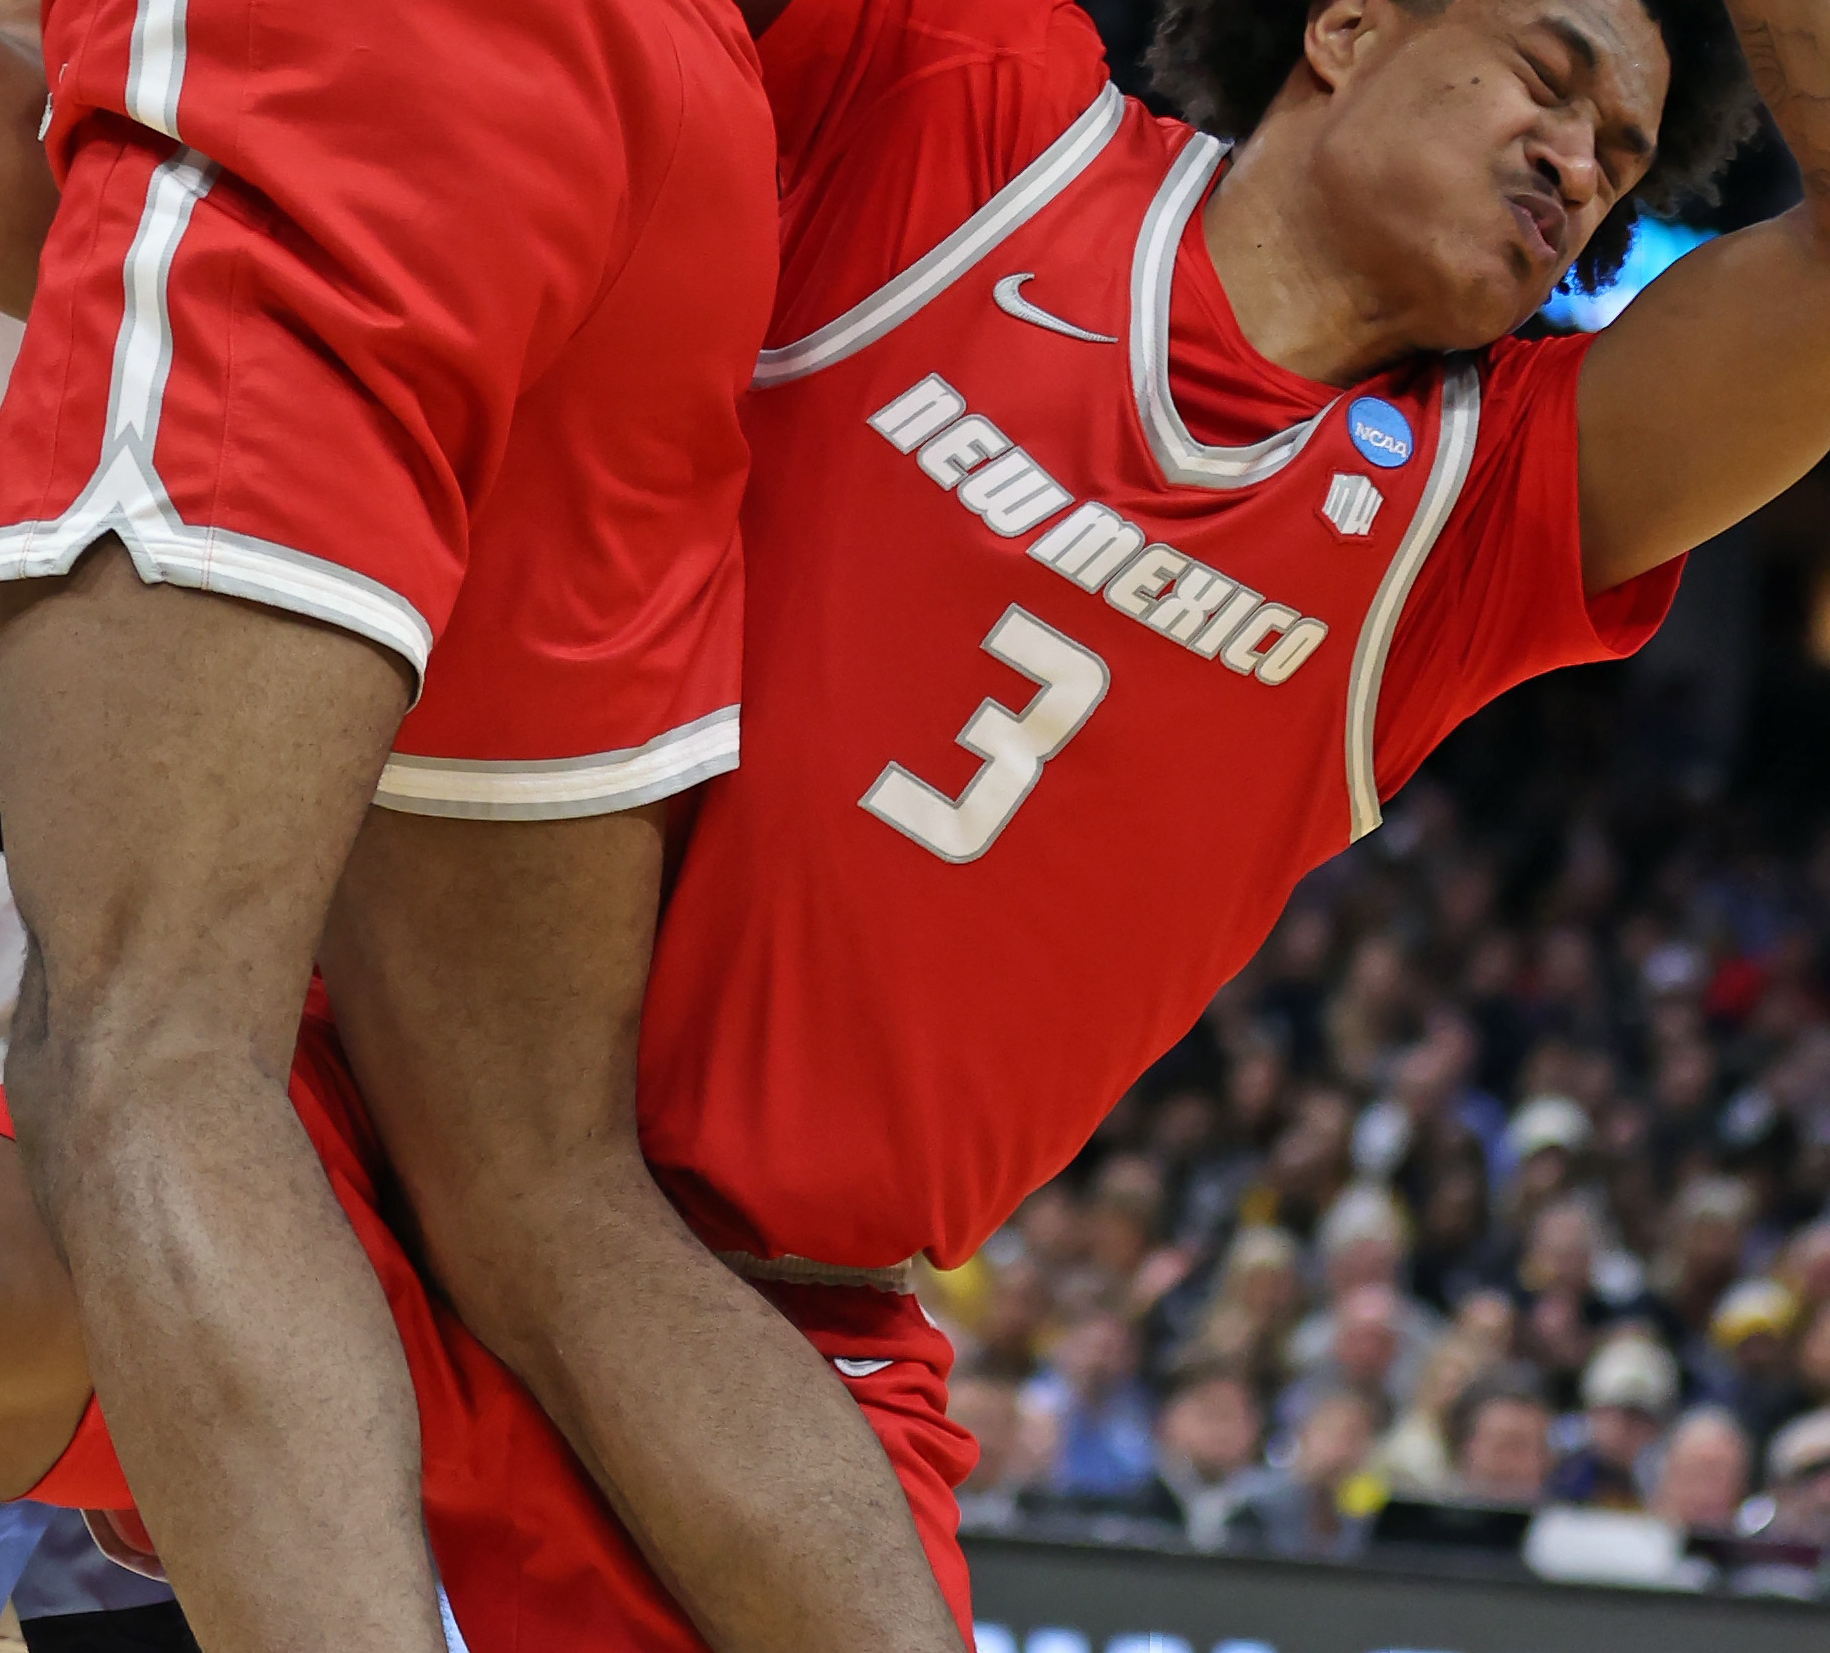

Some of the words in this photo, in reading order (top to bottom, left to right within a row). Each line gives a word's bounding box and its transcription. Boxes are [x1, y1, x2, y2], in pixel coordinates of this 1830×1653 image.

[865, 371, 1075, 539] NEW
[1025, 499, 1330, 687] MEXICO
[1354, 420, 1409, 459] NCAA
[856, 601, 1112, 865] 3
